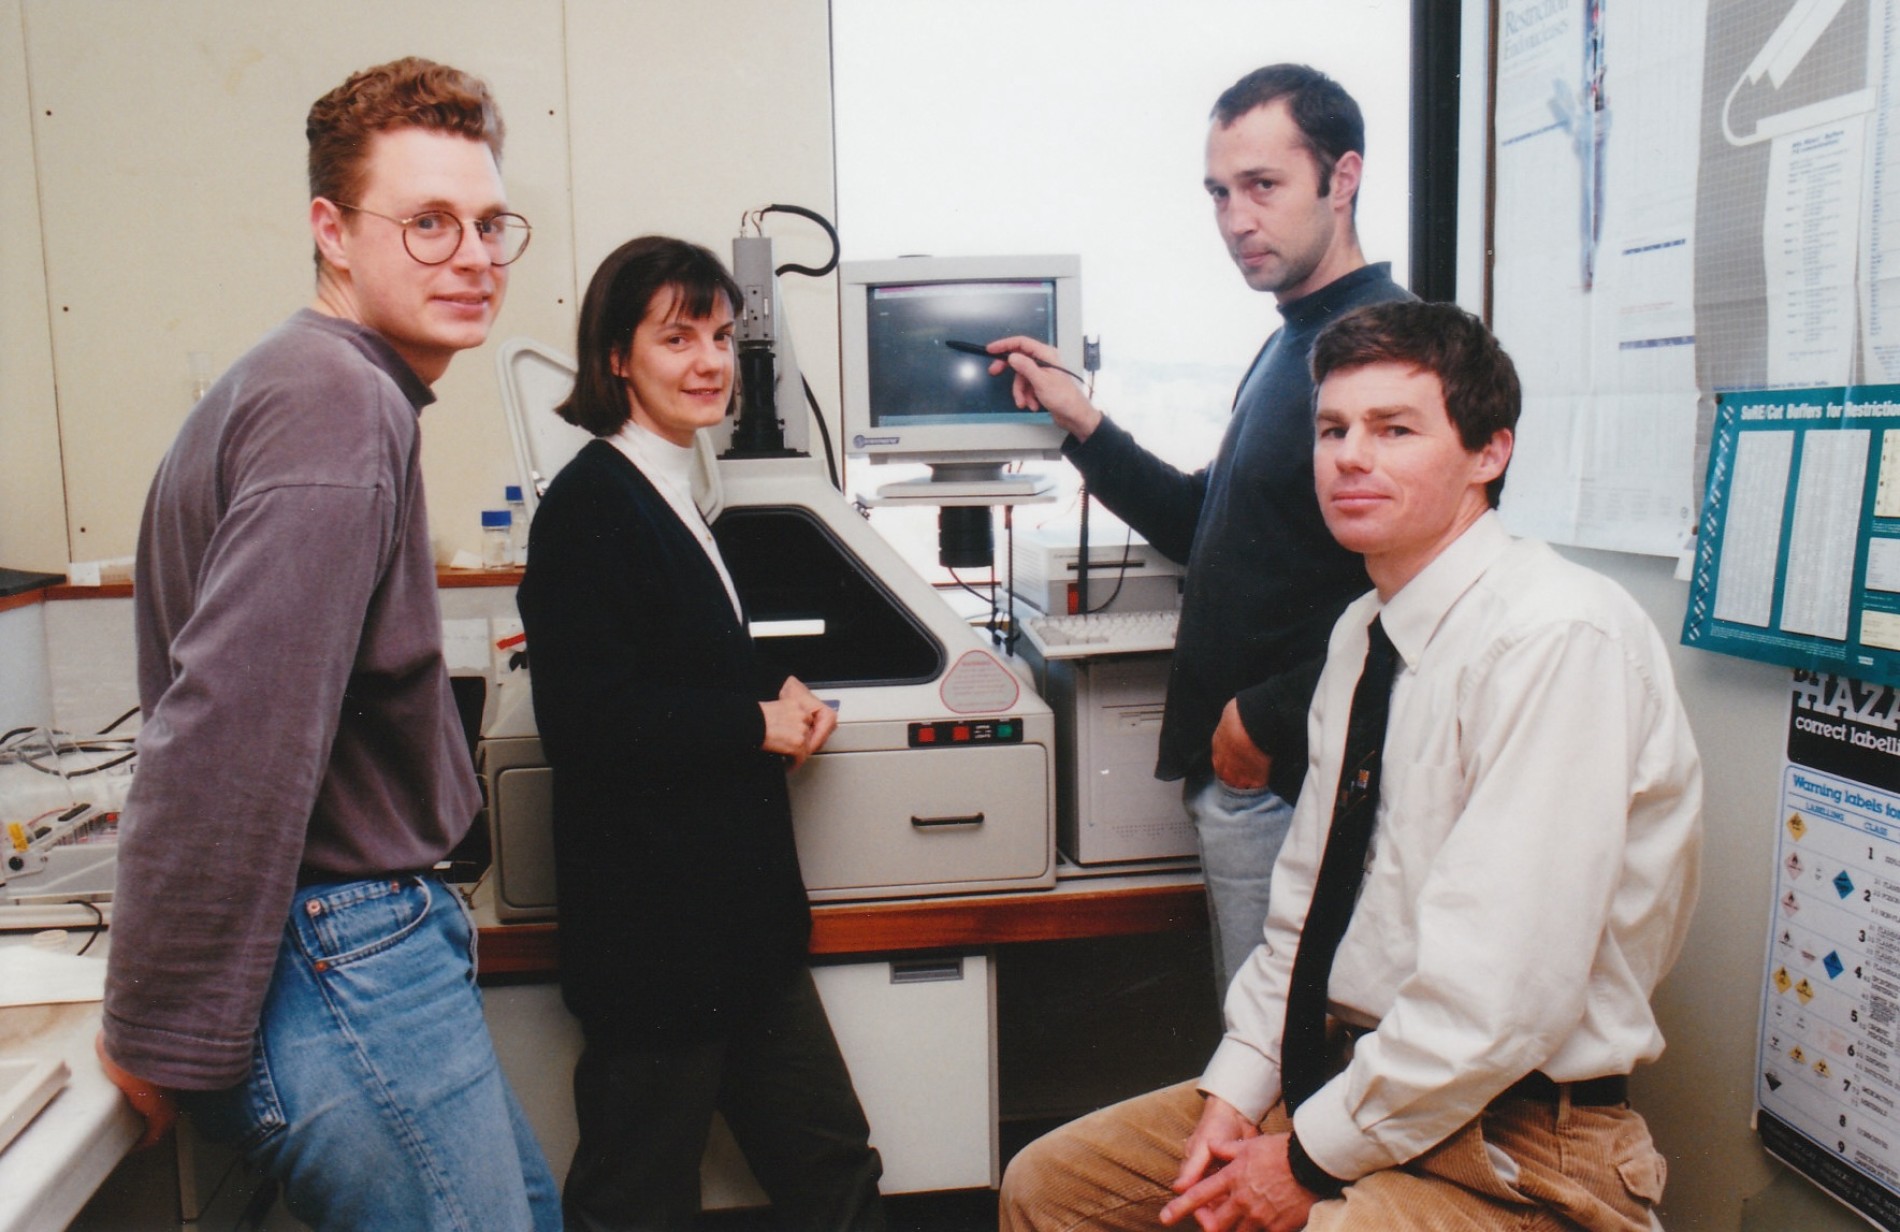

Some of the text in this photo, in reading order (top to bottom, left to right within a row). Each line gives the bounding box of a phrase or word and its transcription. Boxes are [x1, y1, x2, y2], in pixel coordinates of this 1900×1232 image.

[1786, 402, 1823, 419] Buffers
[1826, 401, 1843, 418] for
[1795, 716, 1848, 741] correct
[1793, 774, 1842, 804] Warning
[1844, 790, 1883, 814] labels
[1868, 847, 1873, 860] 1
[1863, 889, 1871, 902] 2
[1858, 929, 1866, 943] 3
[1854, 966, 1862, 979] 4
[1850, 1009, 1858, 1023] 5
[1847, 1044, 1855, 1057] 6
[1843, 1079, 1851, 1092] 7
[1839, 1114, 1846, 1128] 8
[1837, 1140, 1845, 1153] 9
